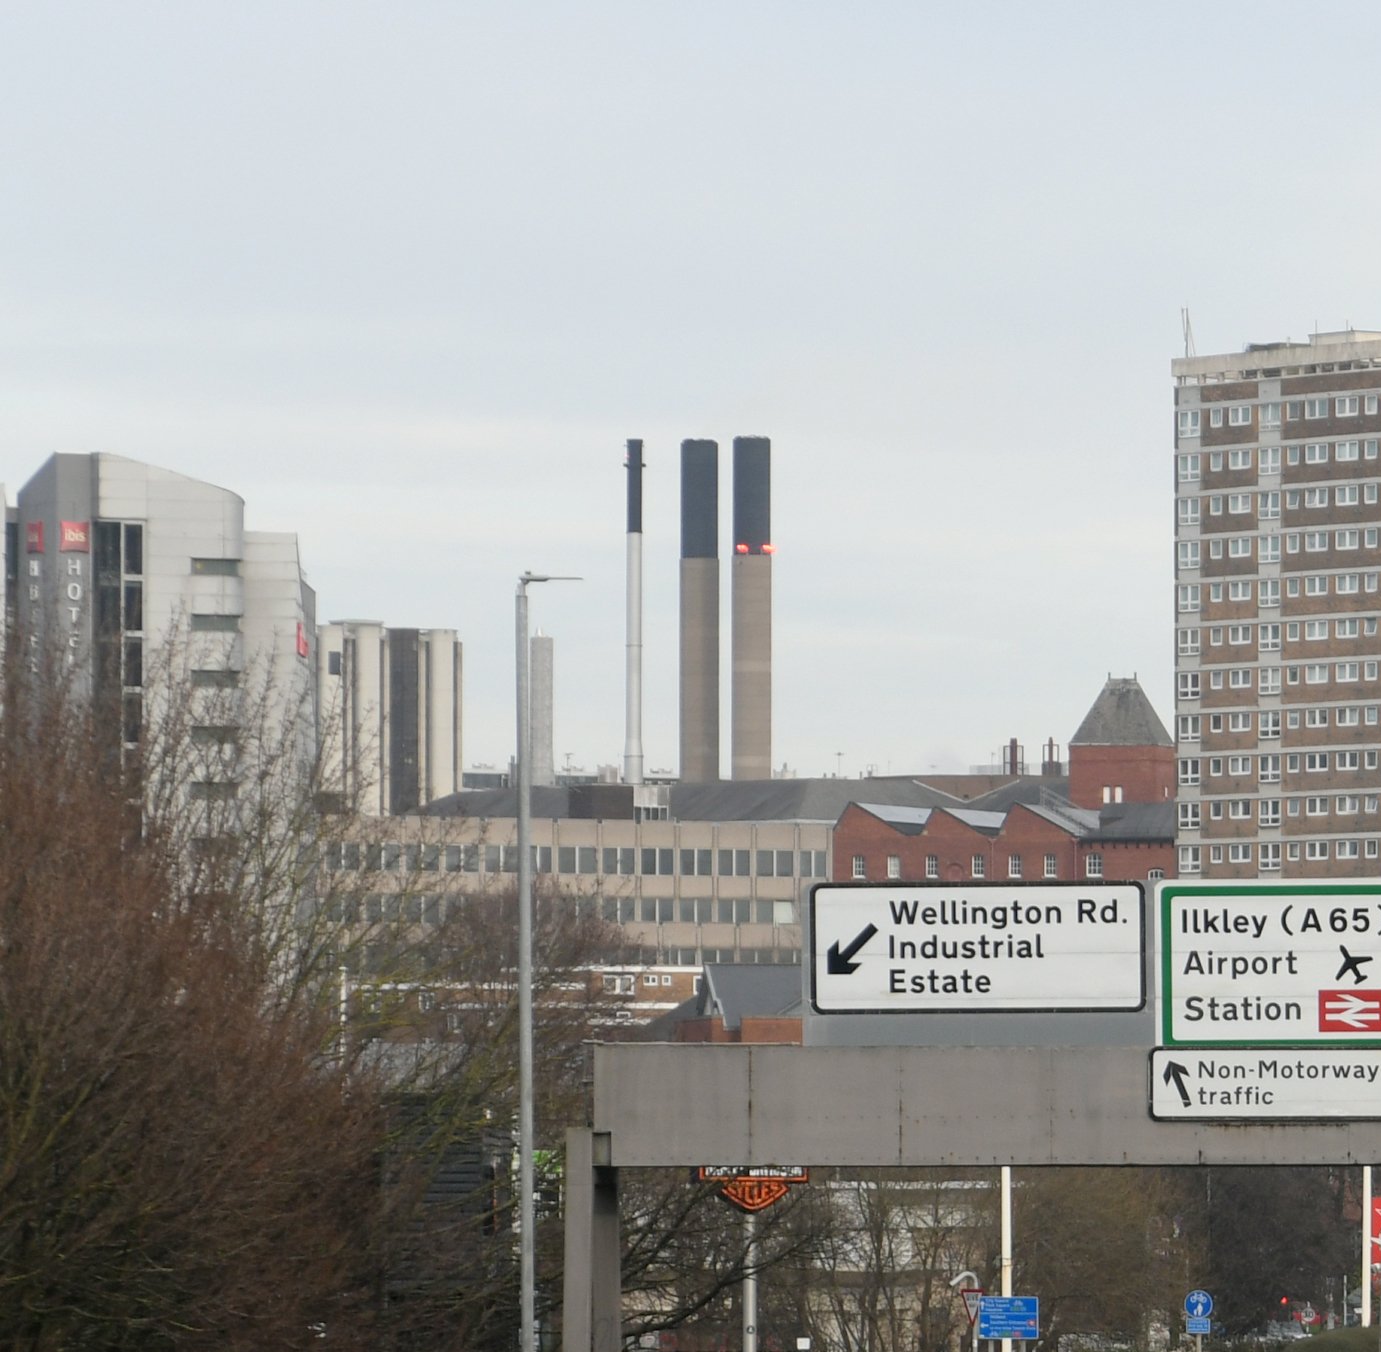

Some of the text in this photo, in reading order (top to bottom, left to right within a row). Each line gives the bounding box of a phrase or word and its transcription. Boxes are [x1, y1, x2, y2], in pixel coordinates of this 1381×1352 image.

[64, 528, 87, 542] ibis
[889, 899, 1128, 931] Wellington Rd.
[1182, 908, 1267, 938] Ilkley
[888, 934, 1044, 960] Industrial
[1183, 951, 1298, 980] Airport
[889, 969, 991, 994] Estate
[1183, 996, 1301, 1022] Station
[1198, 1061, 1380, 1084] Non-Motorway
[1198, 1086, 1274, 1106] traffic
